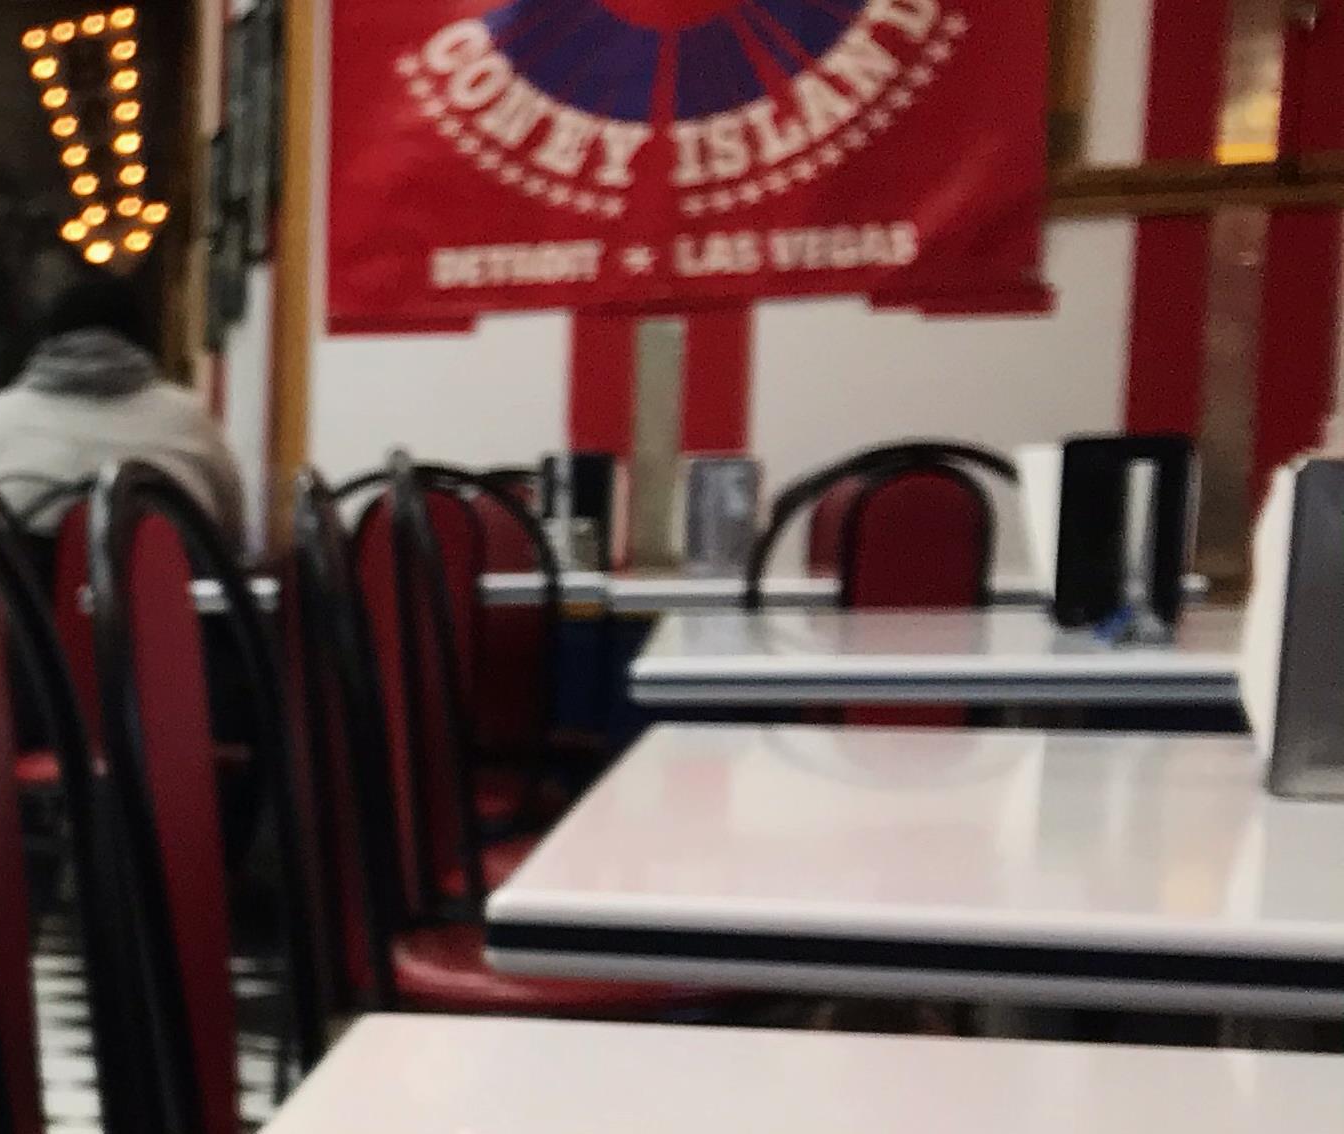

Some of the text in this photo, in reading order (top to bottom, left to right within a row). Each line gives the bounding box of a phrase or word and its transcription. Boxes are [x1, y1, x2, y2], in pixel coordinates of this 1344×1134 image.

[423, 18, 653, 188] CONEY
[430, 220, 918, 288] DETROIT LAS VEGAS
